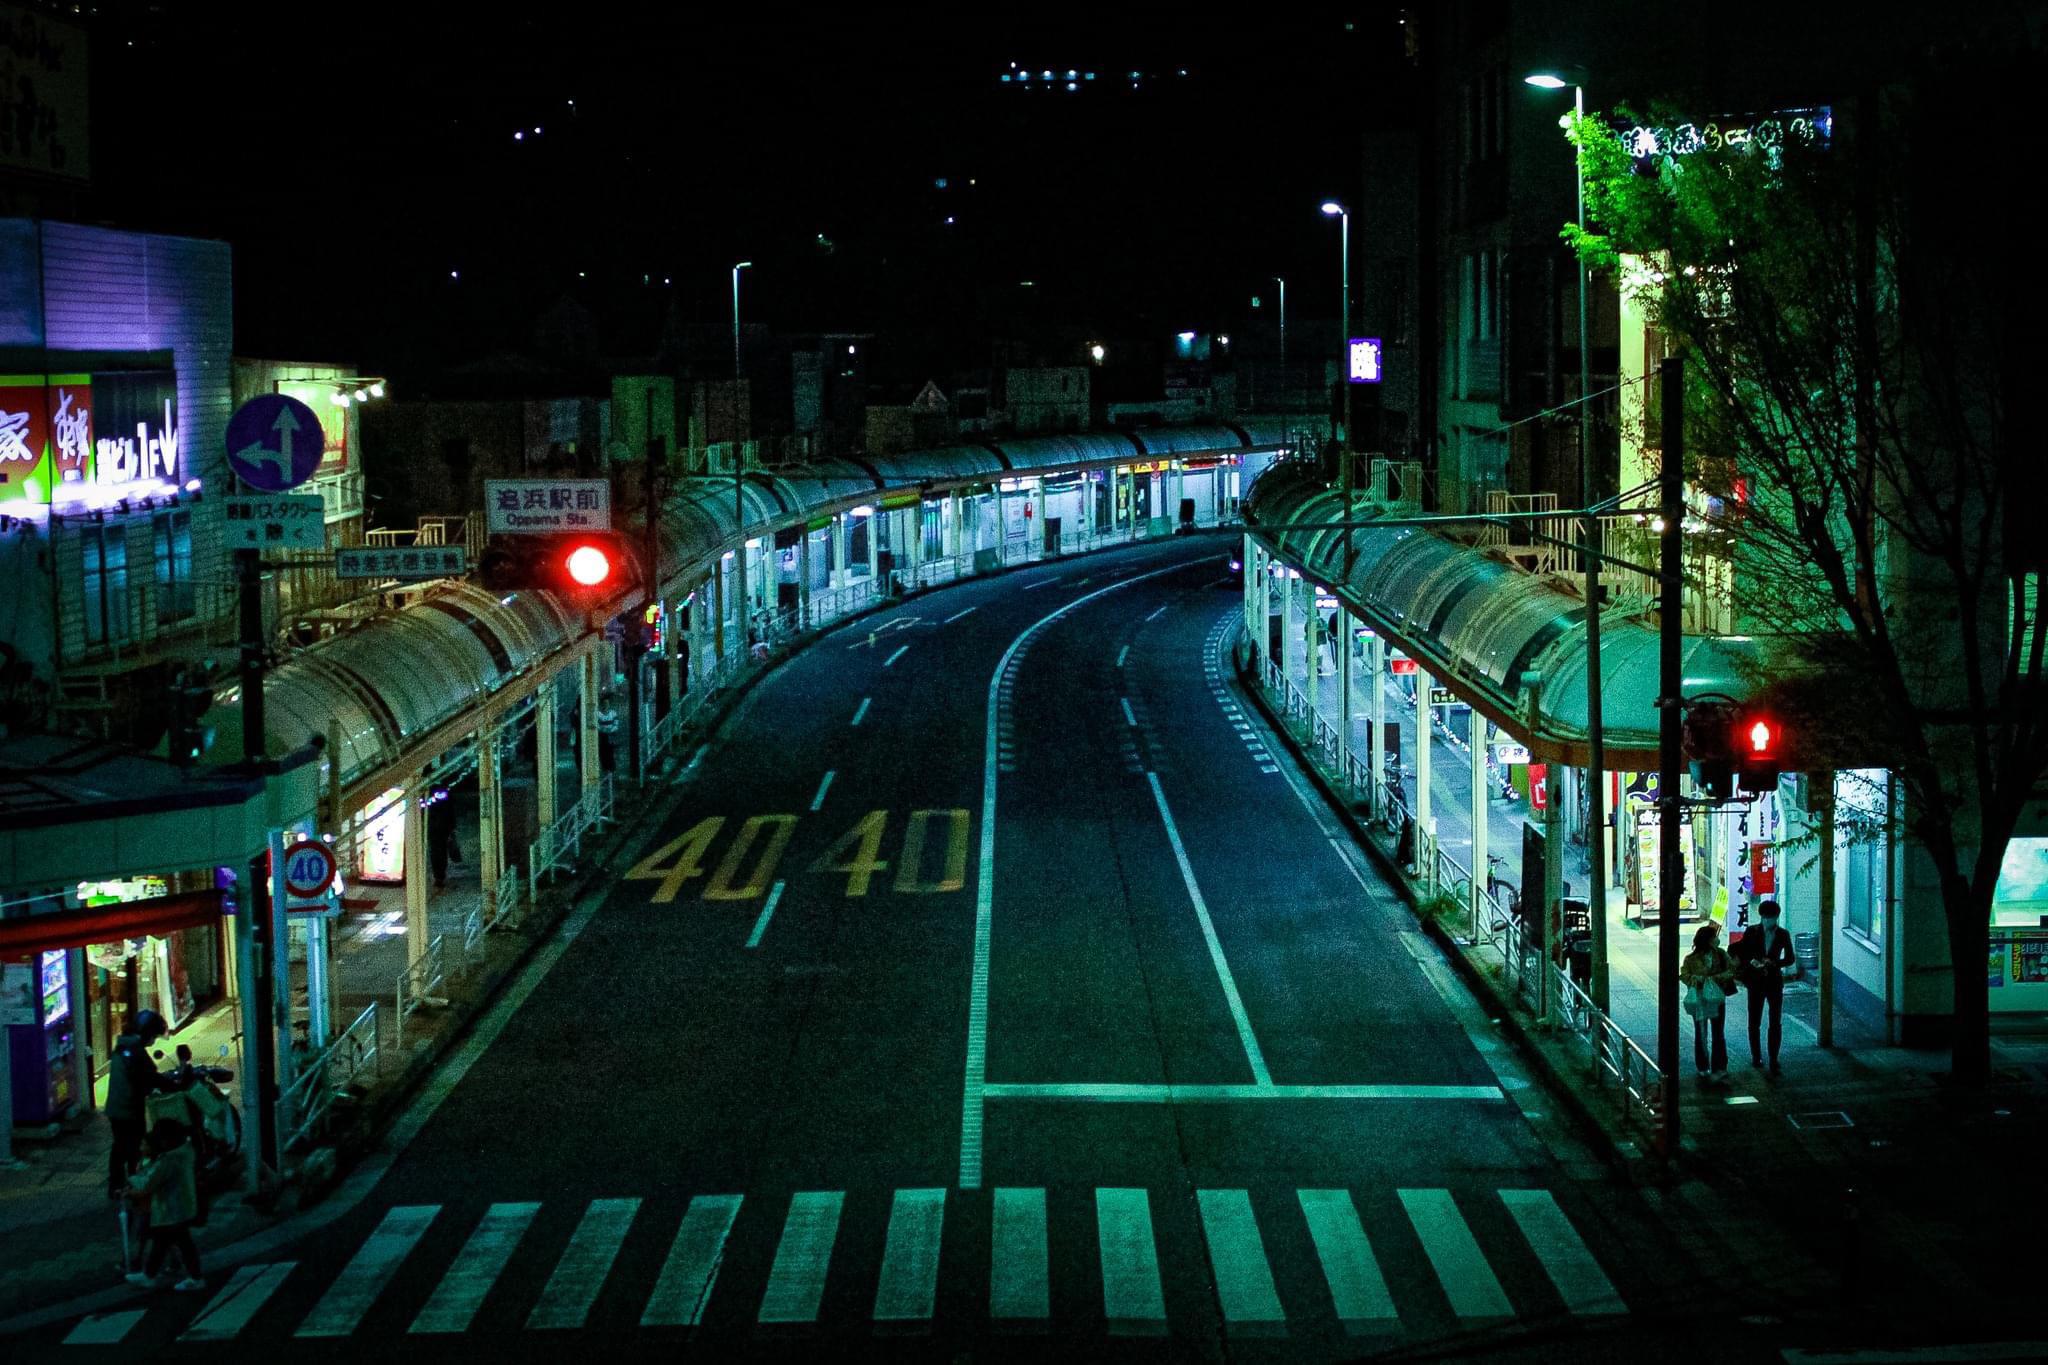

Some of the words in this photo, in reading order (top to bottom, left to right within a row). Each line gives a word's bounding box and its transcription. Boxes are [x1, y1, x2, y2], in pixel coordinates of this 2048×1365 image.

[498, 488, 599, 510] 追浜駅前
[506, 513, 560, 527] Oppama
[624, 816, 799, 903] 40
[806, 808, 971, 897] 40
[290, 855, 326, 882] 40
